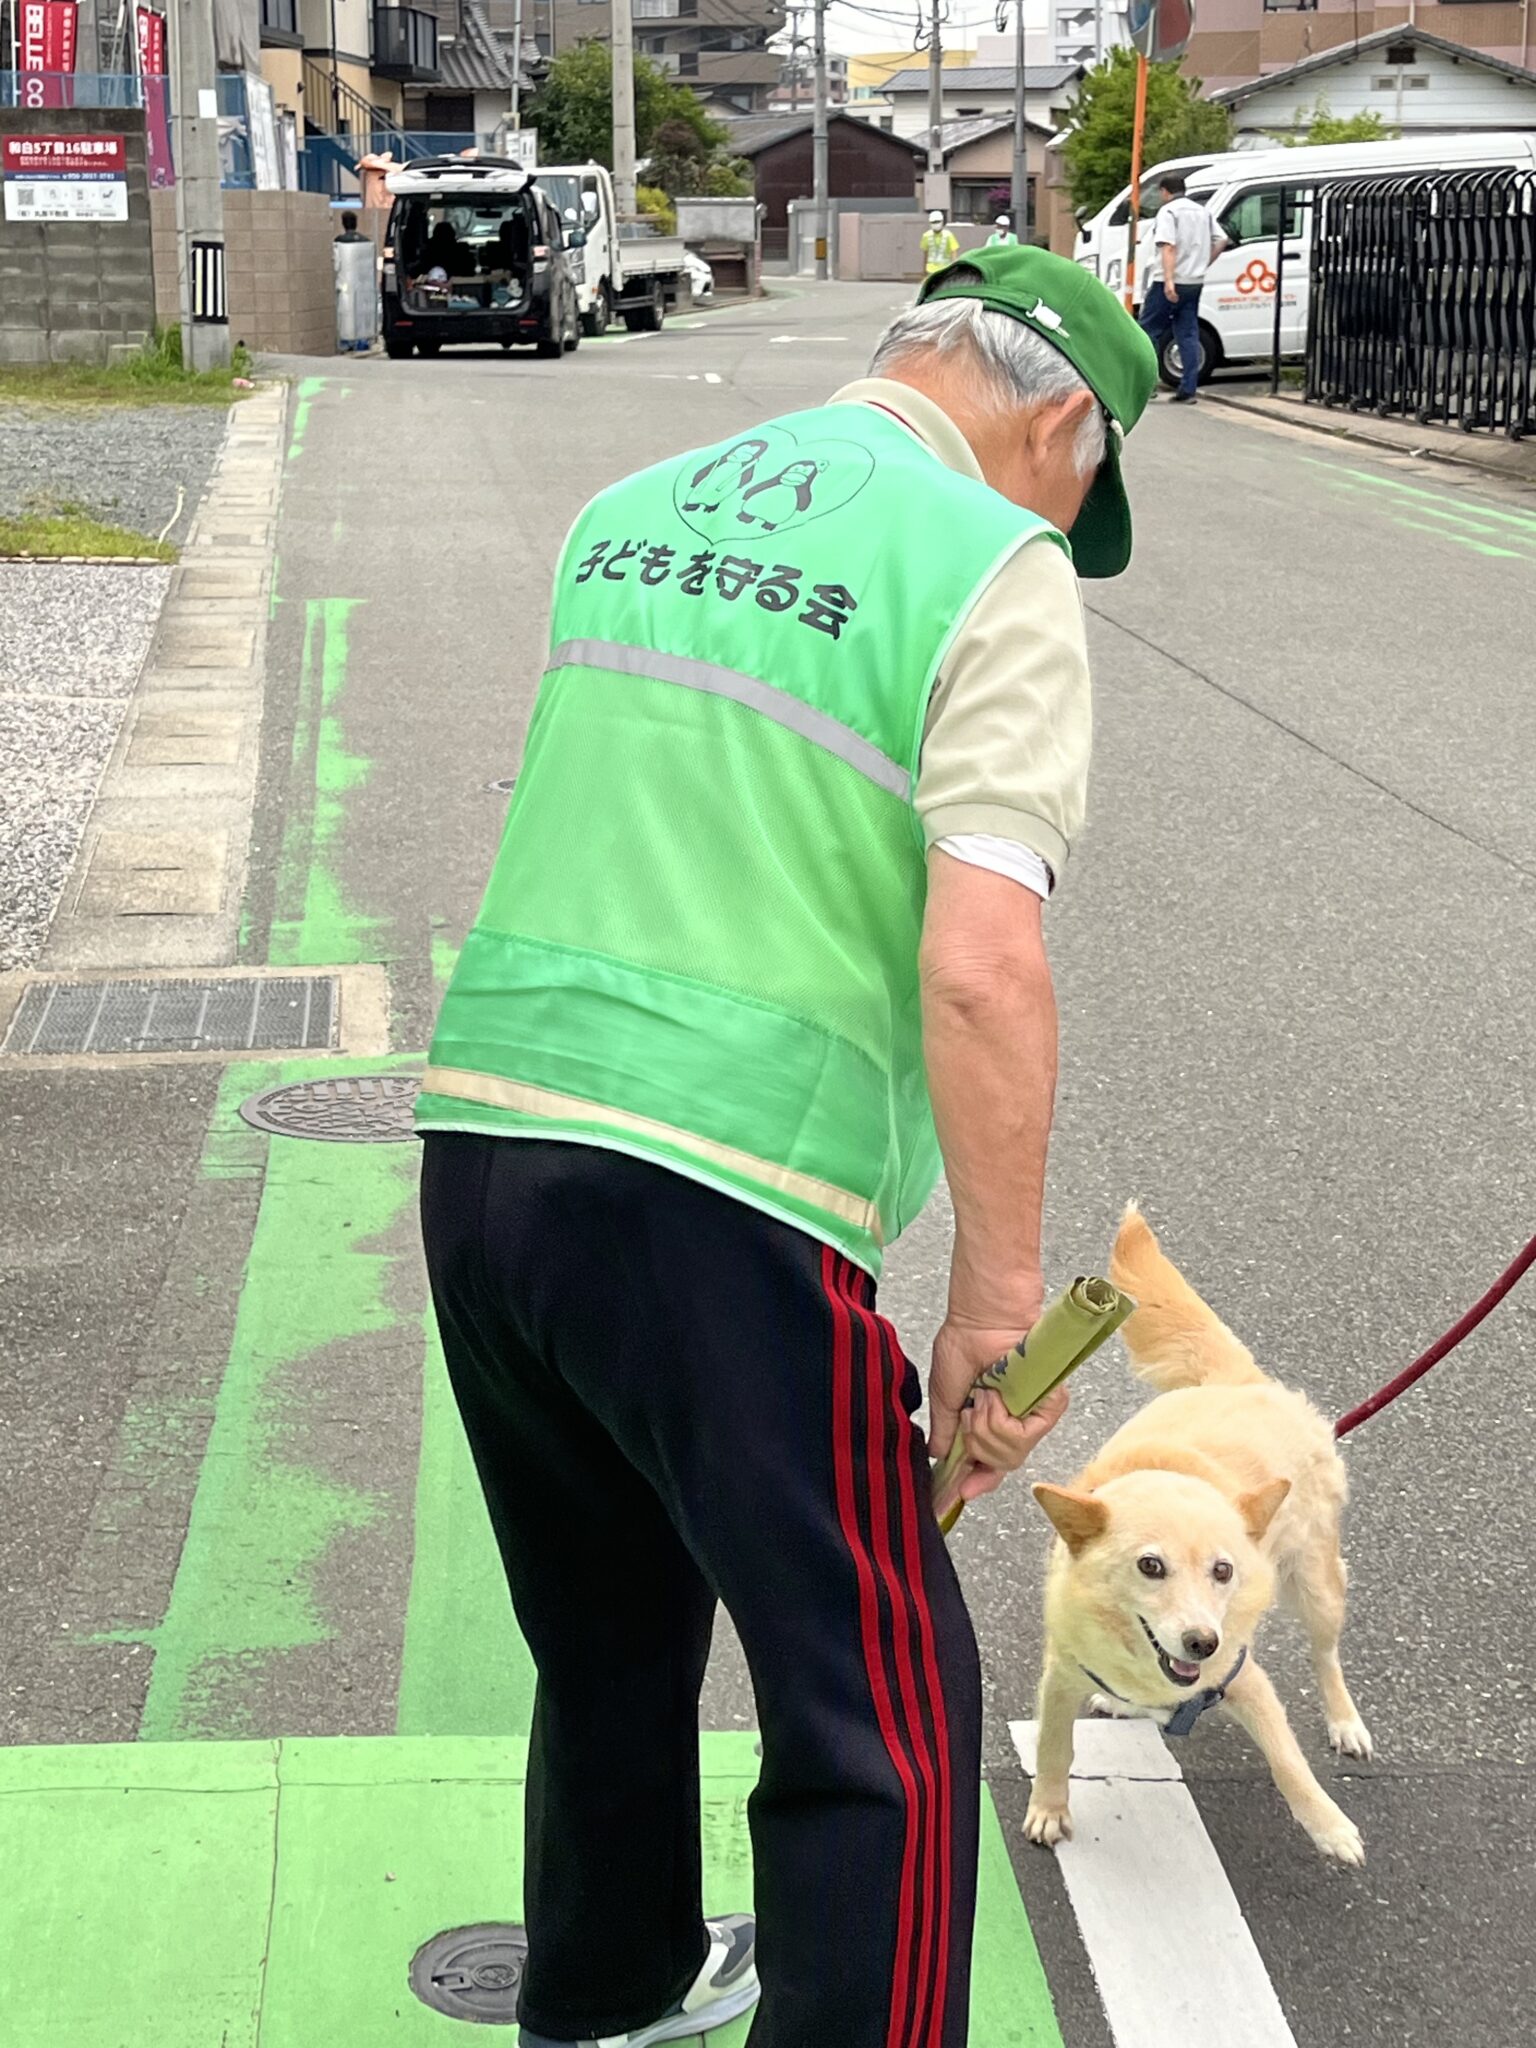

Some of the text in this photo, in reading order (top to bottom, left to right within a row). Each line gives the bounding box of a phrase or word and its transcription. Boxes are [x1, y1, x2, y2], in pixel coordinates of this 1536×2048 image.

[25, 4, 44, 72] BELLE
[575, 539, 858, 641] 子どもを守る会
